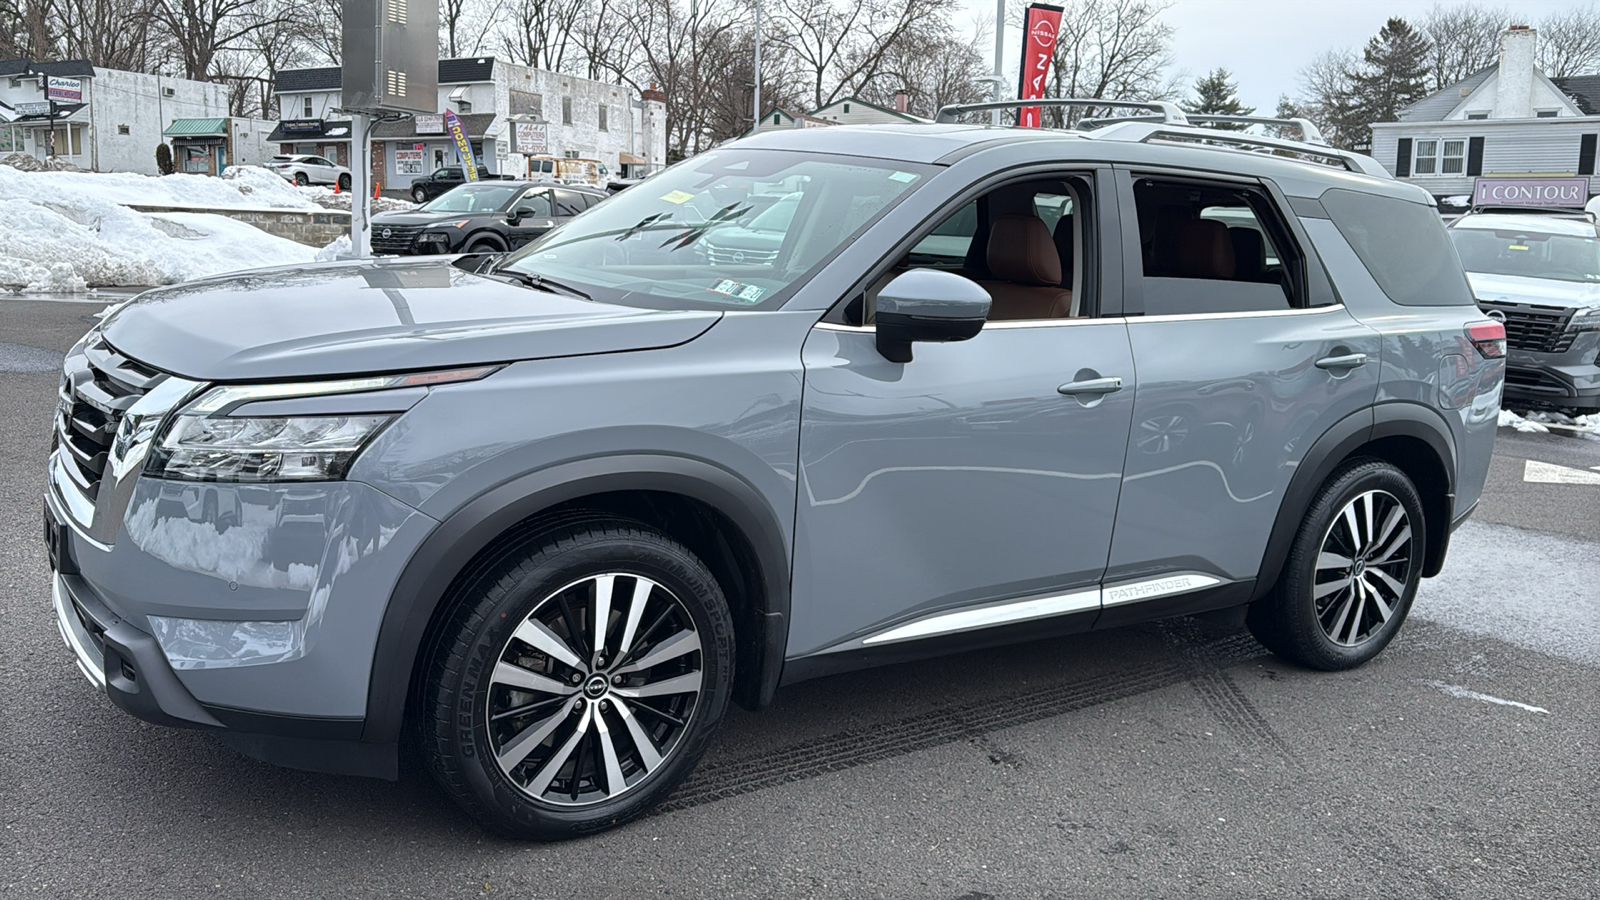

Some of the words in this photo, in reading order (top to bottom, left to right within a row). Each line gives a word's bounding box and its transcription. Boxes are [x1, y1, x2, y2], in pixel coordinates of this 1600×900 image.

[517, 131, 546, 139] COMPUTERS
[1492, 185, 1580, 200] CONTOUR
[1109, 578, 1192, 600] PATHFINDER
